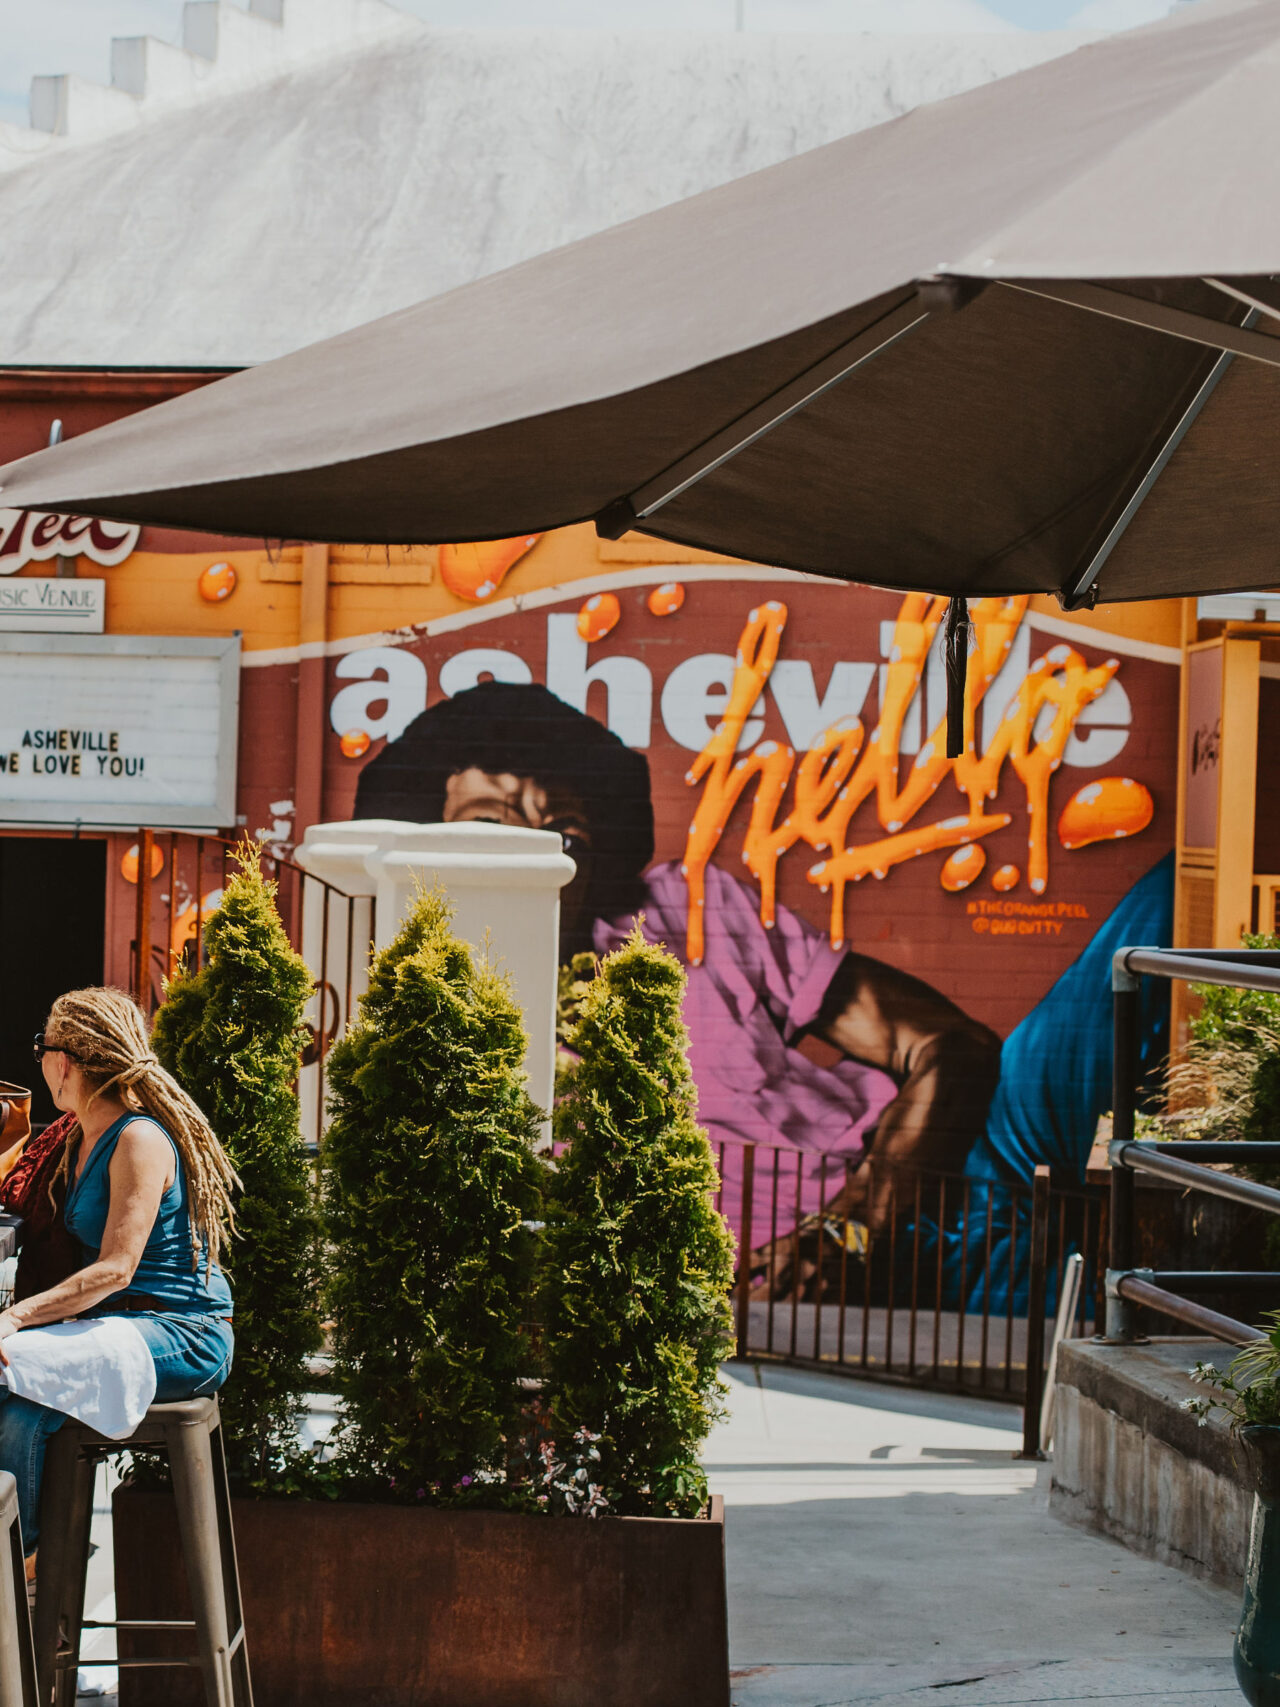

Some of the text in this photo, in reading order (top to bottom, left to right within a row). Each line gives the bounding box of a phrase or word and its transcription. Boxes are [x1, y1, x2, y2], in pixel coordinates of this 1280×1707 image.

[35, 583, 96, 608] VENUE
[22, 729, 119, 752] ASHEVILLE
[33, 754, 81, 776] LOVE
[97, 755, 145, 777] YOU!
